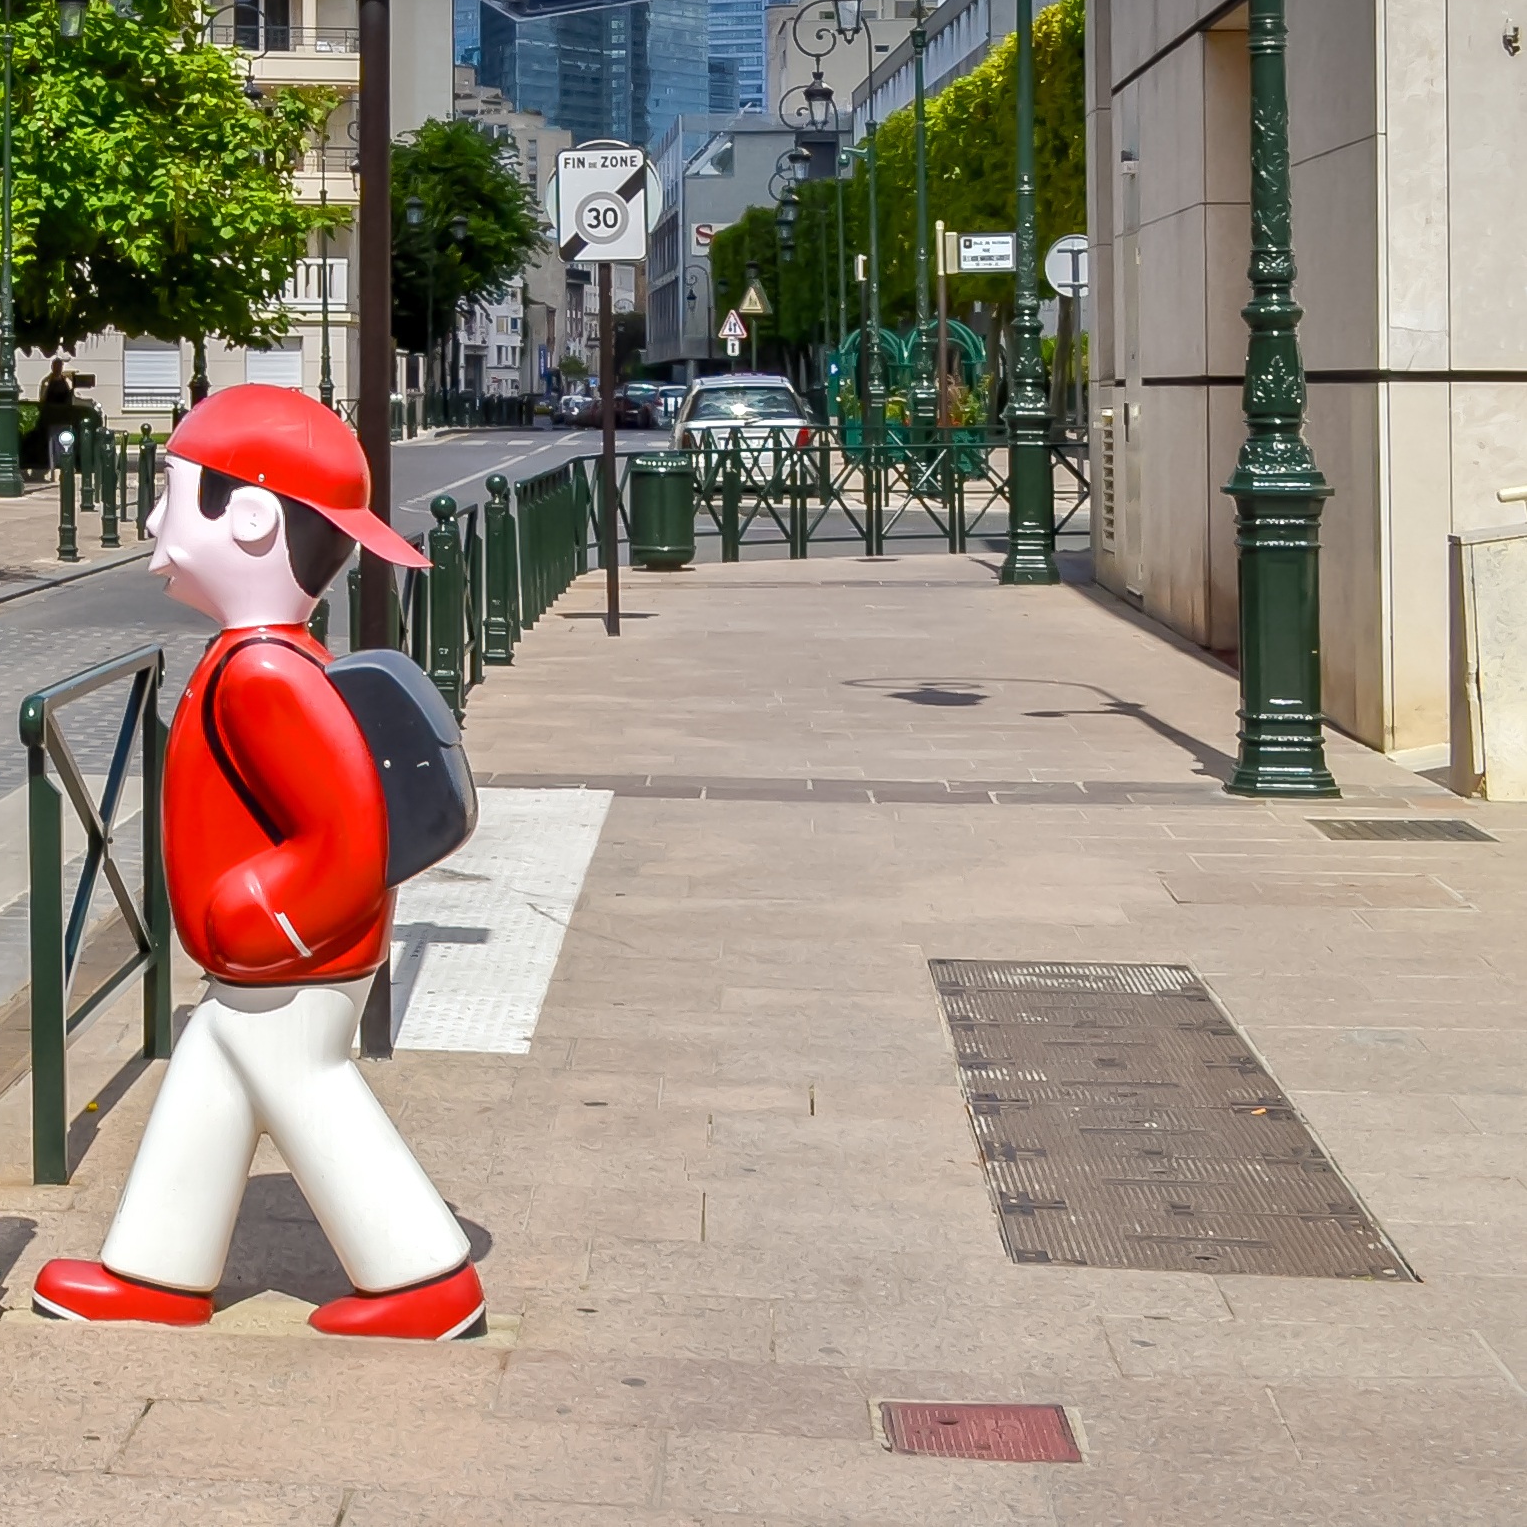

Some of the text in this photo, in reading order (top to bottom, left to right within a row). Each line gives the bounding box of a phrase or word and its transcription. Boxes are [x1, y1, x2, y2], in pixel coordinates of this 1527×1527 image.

[563, 156, 585, 169] FIN
[600, 155, 638, 168] ZONE
[587, 207, 619, 229] 30
